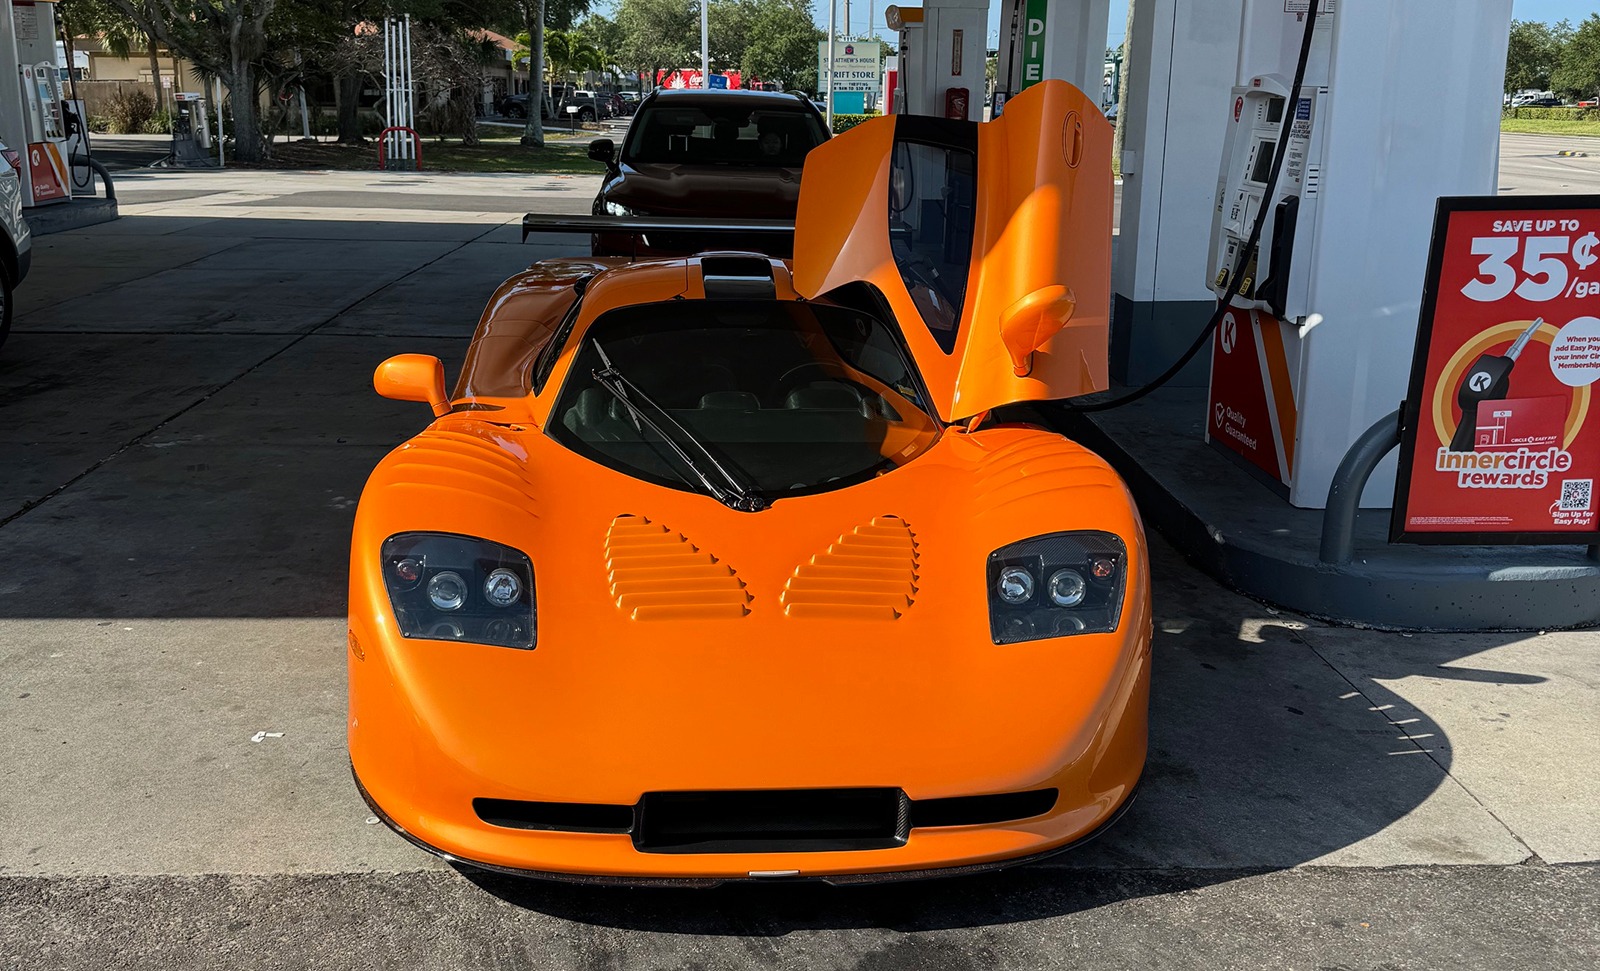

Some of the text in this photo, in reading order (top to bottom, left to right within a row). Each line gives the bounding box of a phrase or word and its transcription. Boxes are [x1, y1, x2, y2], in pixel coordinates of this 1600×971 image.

[1492, 219, 1580, 232] SAVE UP TO
[1226, 406, 1247, 428] Quality
[1225, 422, 1257, 450] Guaranteed
[1439, 449, 1569, 469] innercircle
[1461, 470, 1545, 486] rewards
[1554, 518, 1591, 526] Easy Pay!
